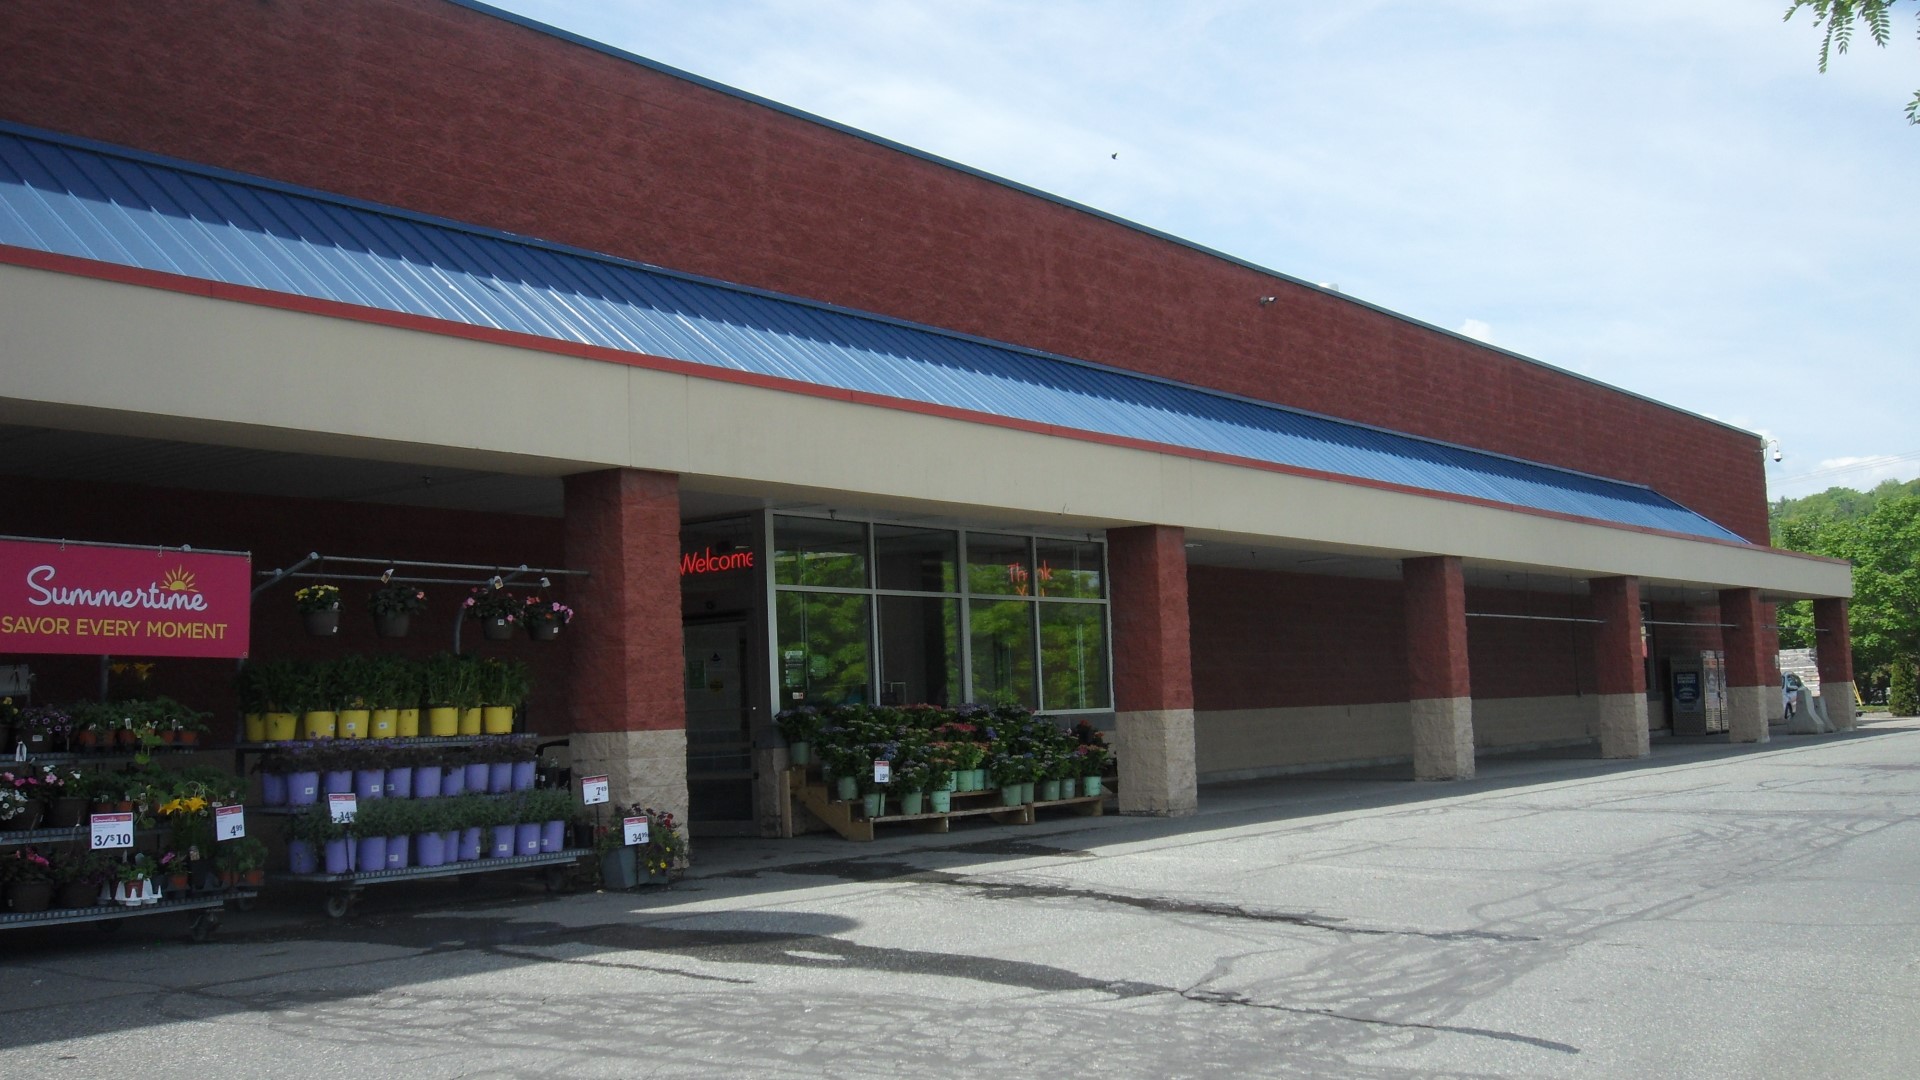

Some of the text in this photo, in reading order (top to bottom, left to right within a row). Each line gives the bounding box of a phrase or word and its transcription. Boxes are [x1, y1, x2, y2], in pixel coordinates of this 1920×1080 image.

[679, 546, 753, 576] Welcome
[1007, 559, 1054, 583] Thnk
[27, 565, 207, 611] Summertime
[1, 616, 228, 640] SAVOR EVERY MOMENT
